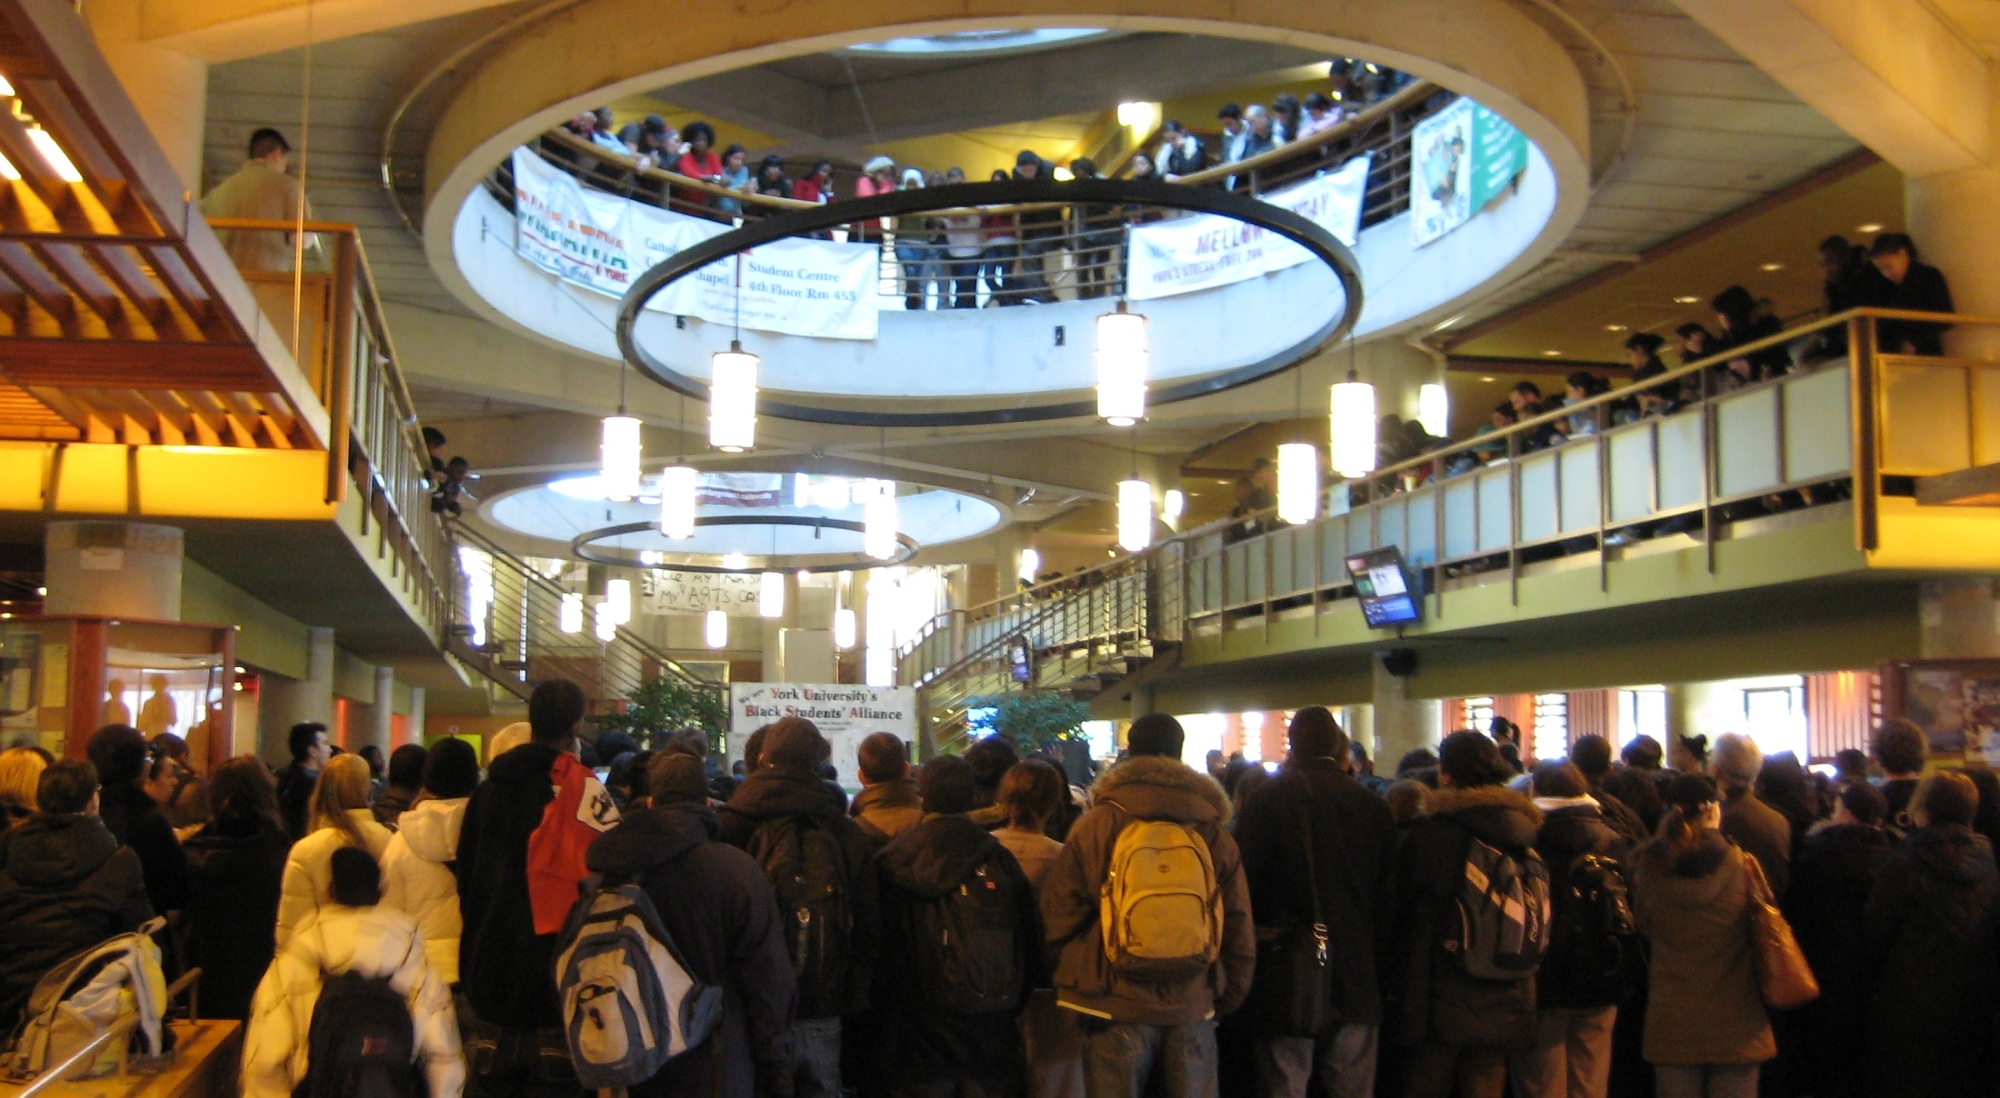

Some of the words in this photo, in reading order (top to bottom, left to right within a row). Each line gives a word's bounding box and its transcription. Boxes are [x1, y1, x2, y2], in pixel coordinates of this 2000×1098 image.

[748, 261, 794, 278] Student
[797, 268, 840, 282] Centre
[749, 281, 768, 292] 4th
[771, 283, 803, 298] Floor
[807, 288, 829, 300] Rm
[770, 687, 800, 700] York
[804, 688, 878, 704] University's
[745, 705, 781, 717] Black
[785, 705, 847, 719] Students'
[850, 706, 903, 720] Alliance
